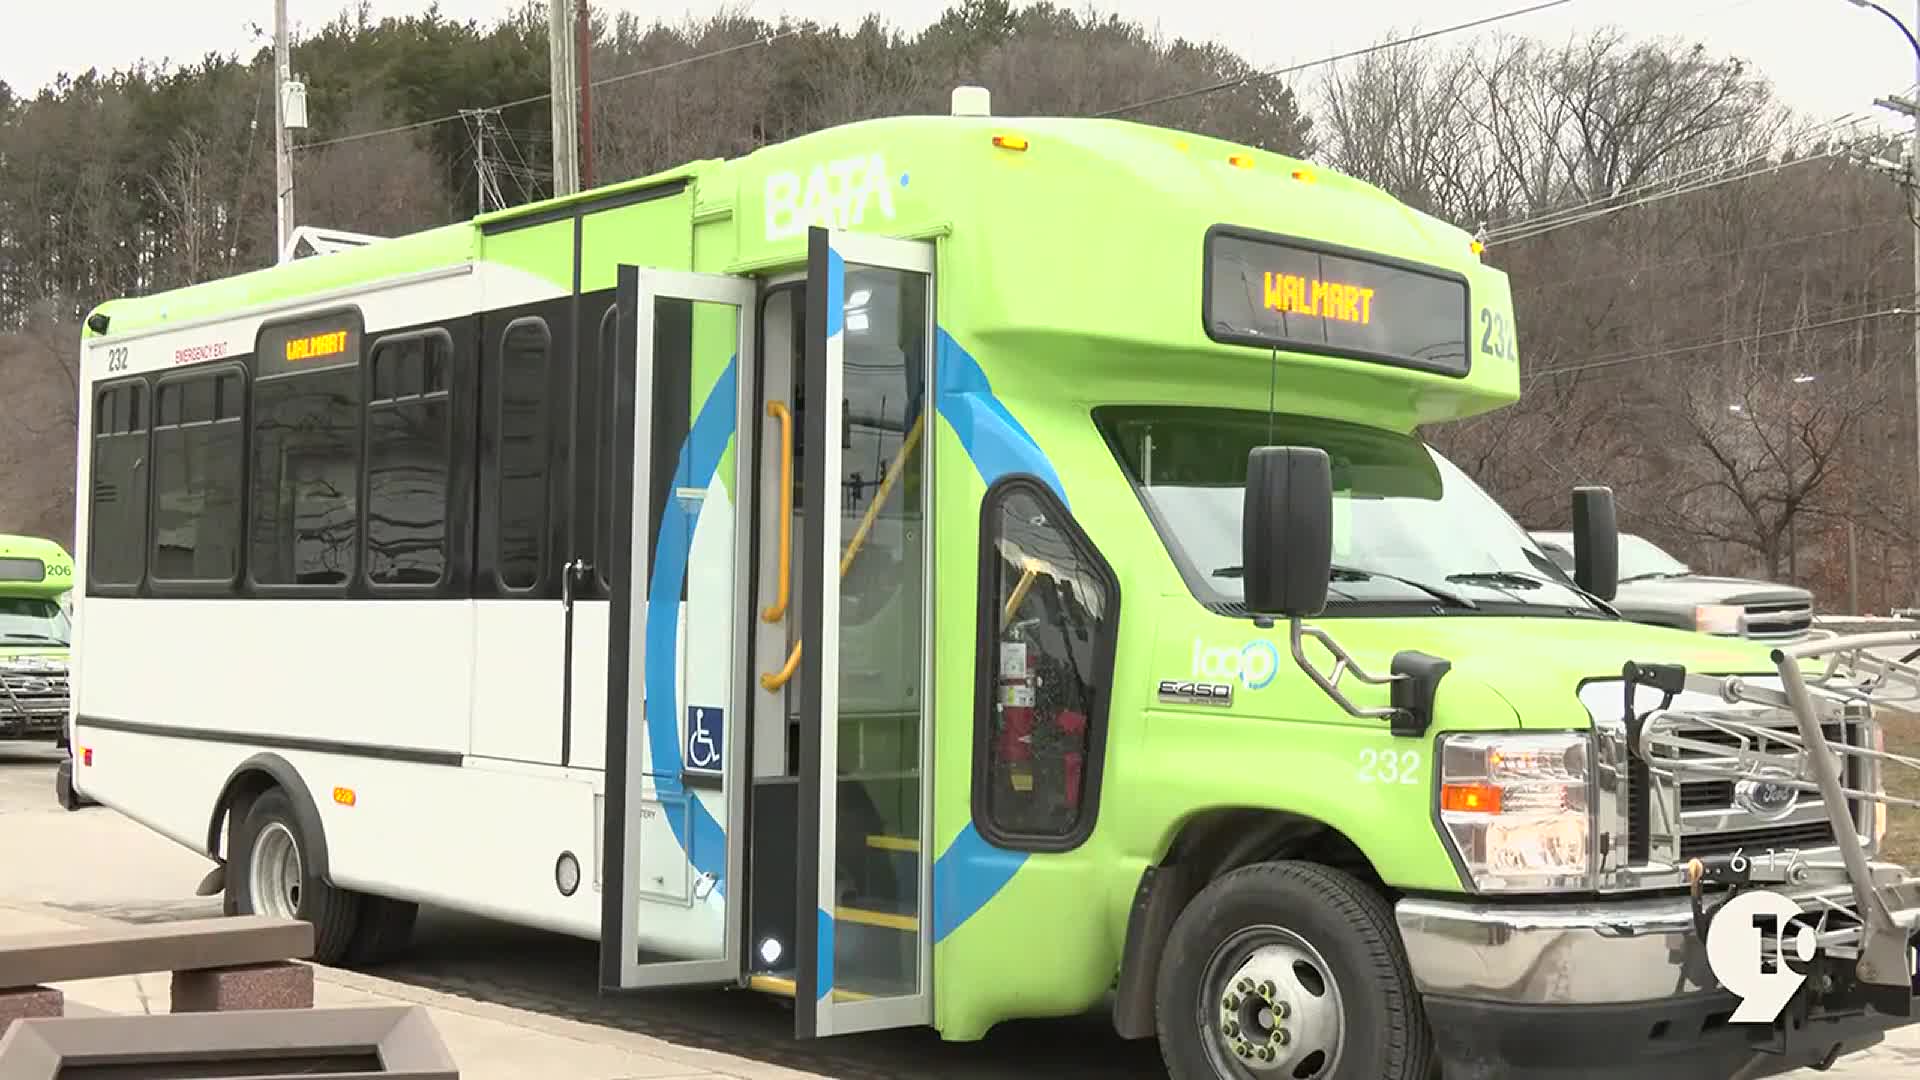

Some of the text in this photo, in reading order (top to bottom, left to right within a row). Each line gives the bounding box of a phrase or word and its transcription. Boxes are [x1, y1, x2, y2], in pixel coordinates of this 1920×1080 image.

[764, 153, 895, 241] BATA
[1263, 271, 1376, 325] WALMART
[108, 347, 128, 371] 232
[175, 345, 212, 364] EMERGENCY
[286, 331, 347, 361] WALMART
[47, 564, 72, 576] 206
[1192, 638, 1276, 689] loop
[1357, 747, 1420, 785] 232
